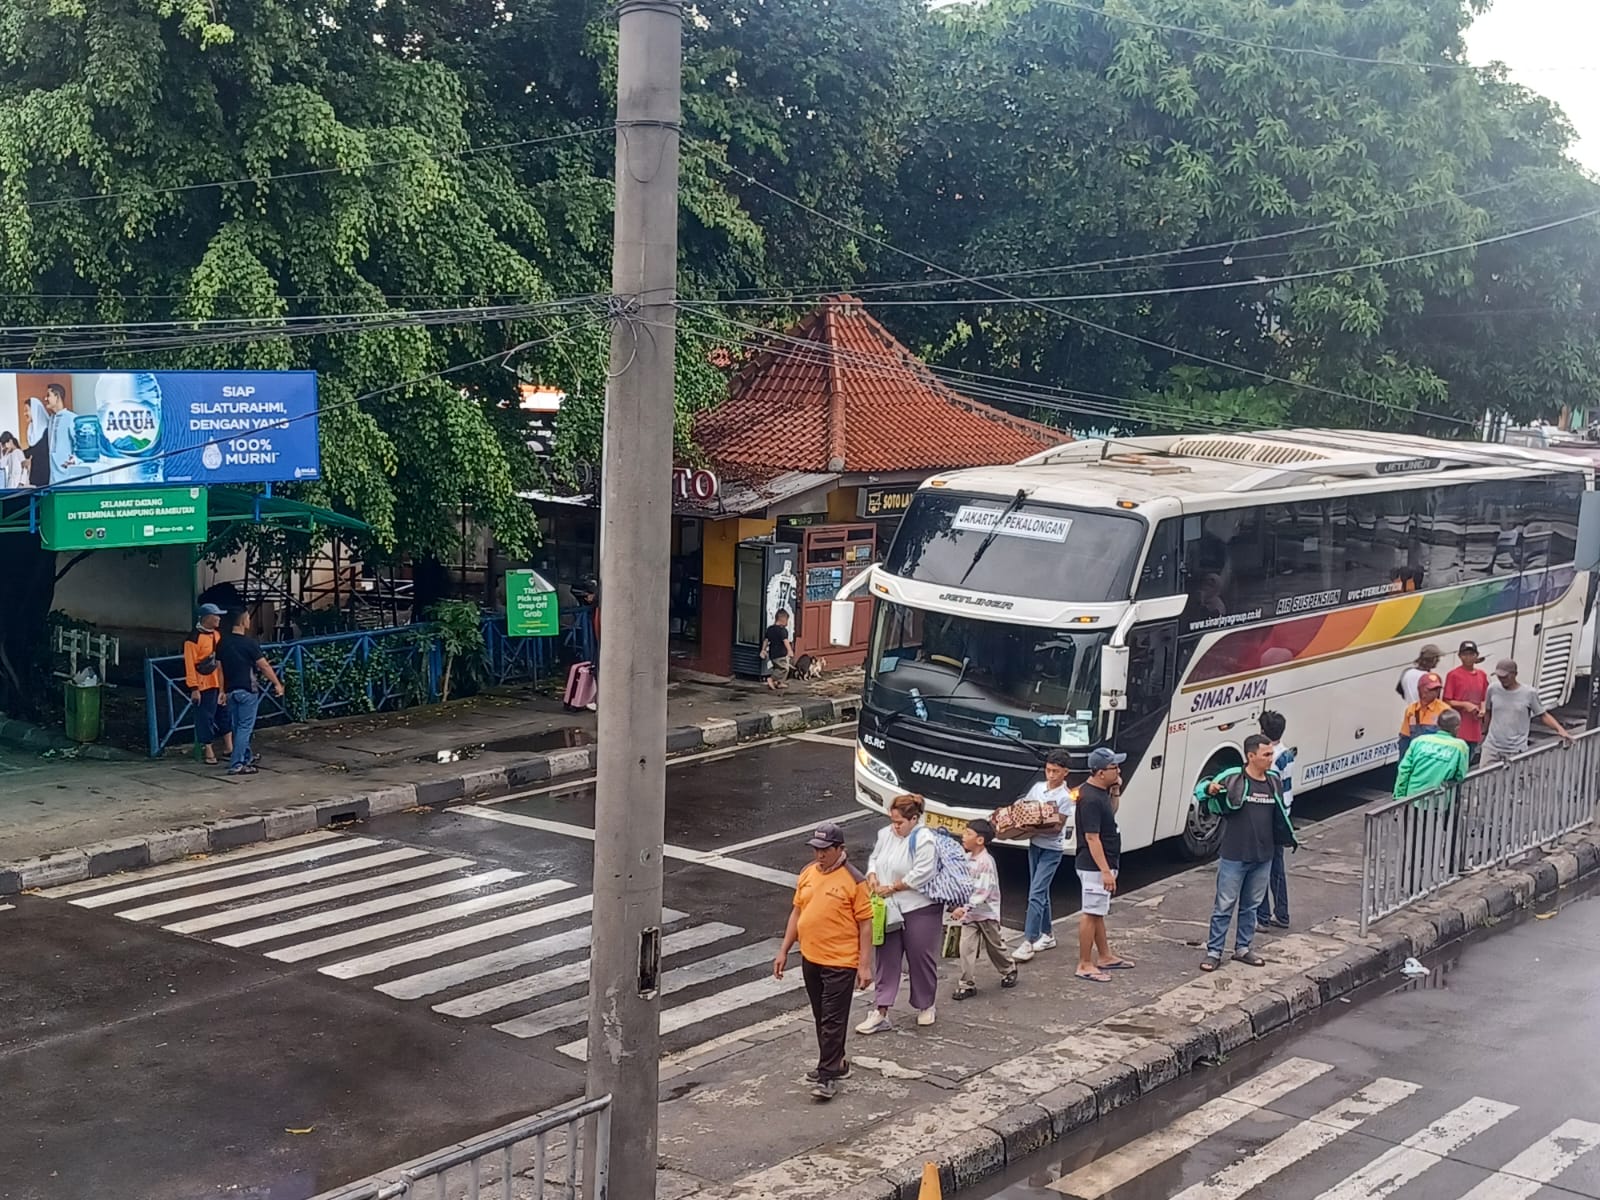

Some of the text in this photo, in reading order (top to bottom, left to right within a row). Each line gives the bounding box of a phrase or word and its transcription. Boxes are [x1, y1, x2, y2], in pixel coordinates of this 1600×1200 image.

[222, 386, 255, 397] SIAP
[190, 402, 287, 415] SILATURAHMI,
[106, 410, 156, 434] AQUA
[190, 418, 290, 431] DENGAN YANG
[228, 439, 272, 452] 100%
[100, 500, 134, 509] SELAMAT
[883, 493, 914, 509] SOTO LA
[67, 512, 77, 520] DI
[77, 510, 115, 520] TERMINAL
[116, 508, 154, 518] KAMPUNG
[959, 510, 1066, 536] JAKARTA PEKALONGAN
[938, 593, 1014, 610] JETLINER
[1276, 589, 1342, 615] AIR SUSPENSION
[1190, 679, 1269, 713] SINAR JAYA
[864, 734, 886, 749] 85.RC
[1304, 762, 1330, 780] ANTAR
[1330, 756, 1350, 773] KOTA
[1350, 748, 1374, 766] ANTAR
[910, 760, 1001, 790] SINAR JAYA
